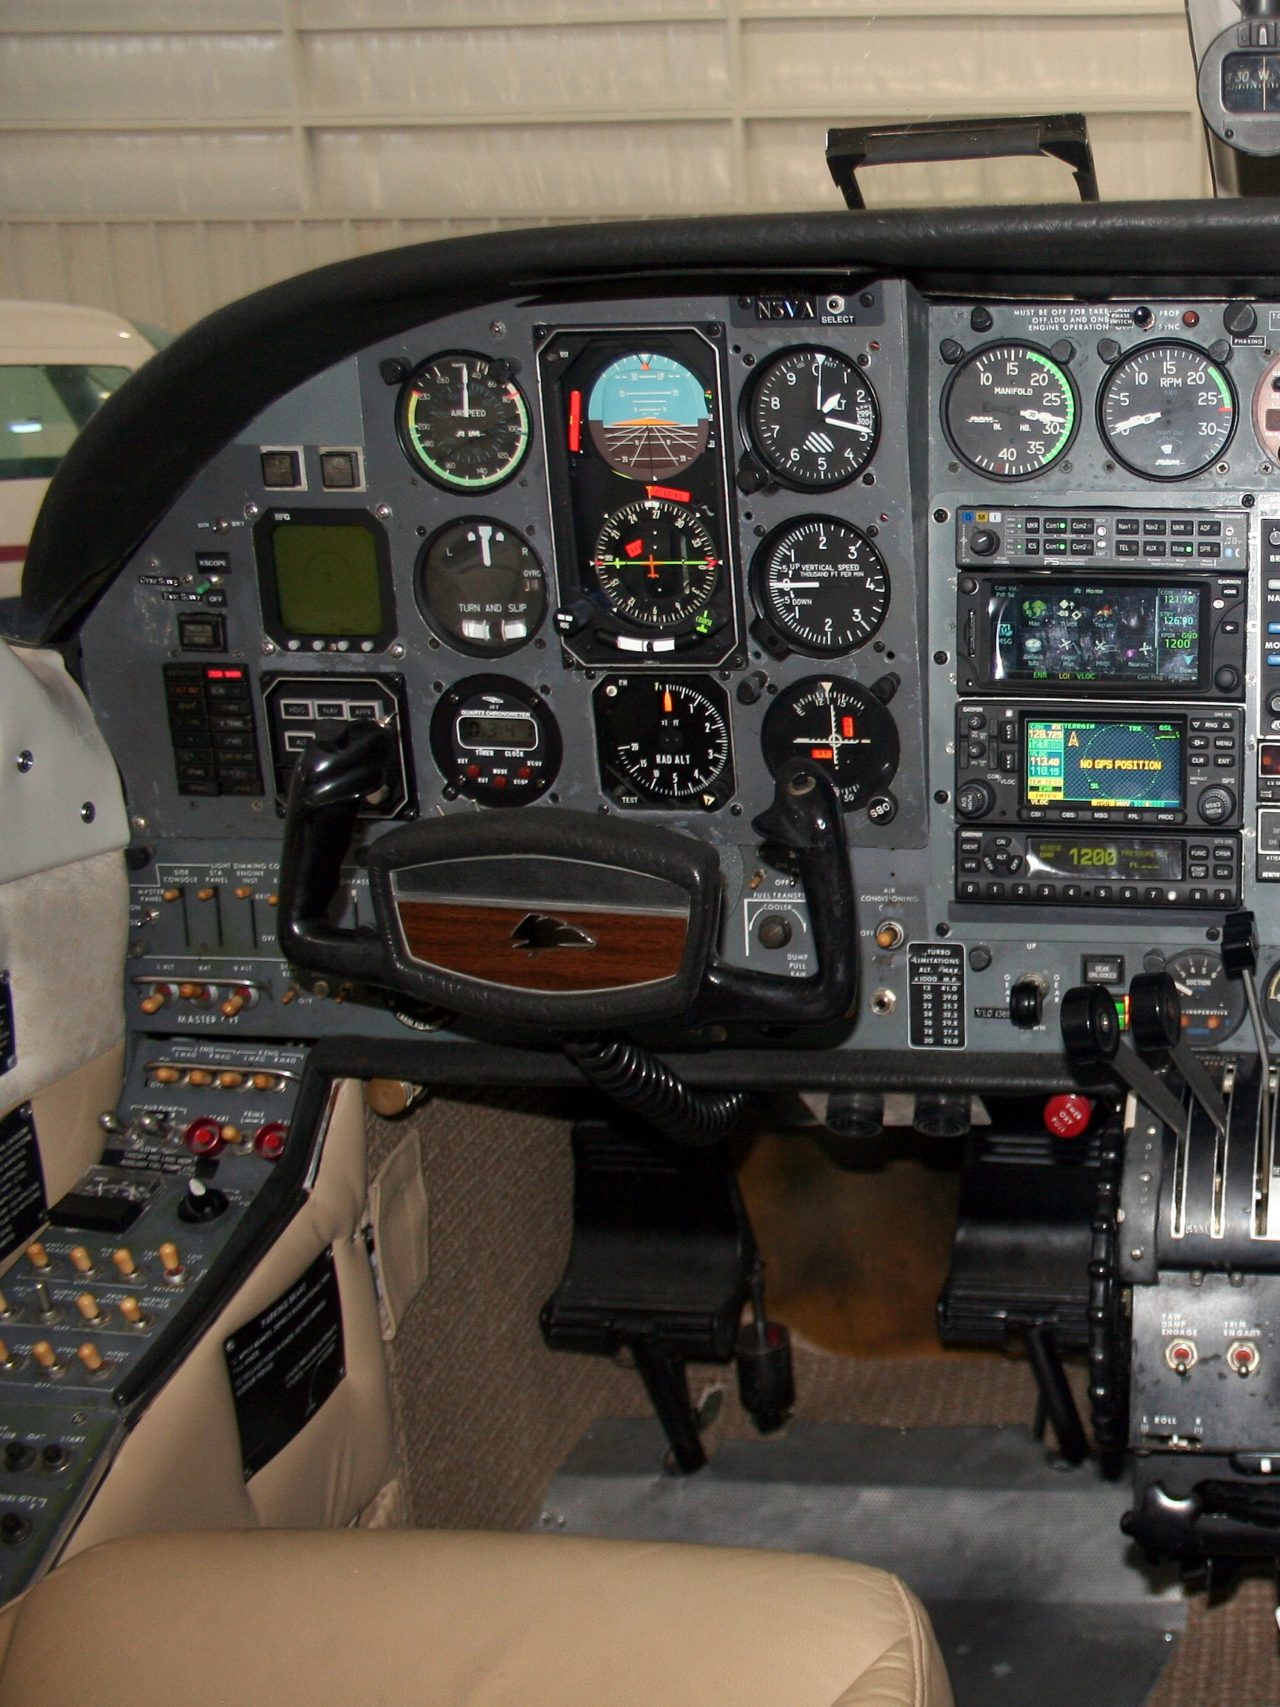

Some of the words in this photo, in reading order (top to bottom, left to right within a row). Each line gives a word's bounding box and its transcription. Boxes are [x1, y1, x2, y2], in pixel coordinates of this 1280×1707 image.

[1235, 71, 1249, 82] 30
[1030, 374, 1049, 386] 20
[1160, 378, 1182, 387] RPM
[994, 388, 1033, 396] MANIFOLD
[1043, 394, 1061, 406] 25
[1198, 393, 1217, 405] 25
[1042, 423, 1060, 435] 30
[1198, 424, 1217, 435] 30
[1027, 442, 1045, 455] 35
[999, 449, 1017, 461] 40
[801, 564, 835, 572] VERTICAL
[837, 564, 860, 572] SPEED
[458, 604, 480, 612] TURN
[486, 604, 502, 613] AND
[508, 604, 527, 613] SLIP
[1164, 640, 1191, 649] 1200
[656, 755, 672, 764] RAD
[675, 755, 690, 765] ALT
[1080, 760, 1092, 769] NO
[1096, 760, 1112, 769] GPS
[1114, 760, 1161, 770] POSITION
[870, 802, 890, 818] OBS
[1069, 848, 1117, 866] 1200
[1186, 979, 1211, 987] SUCTION
